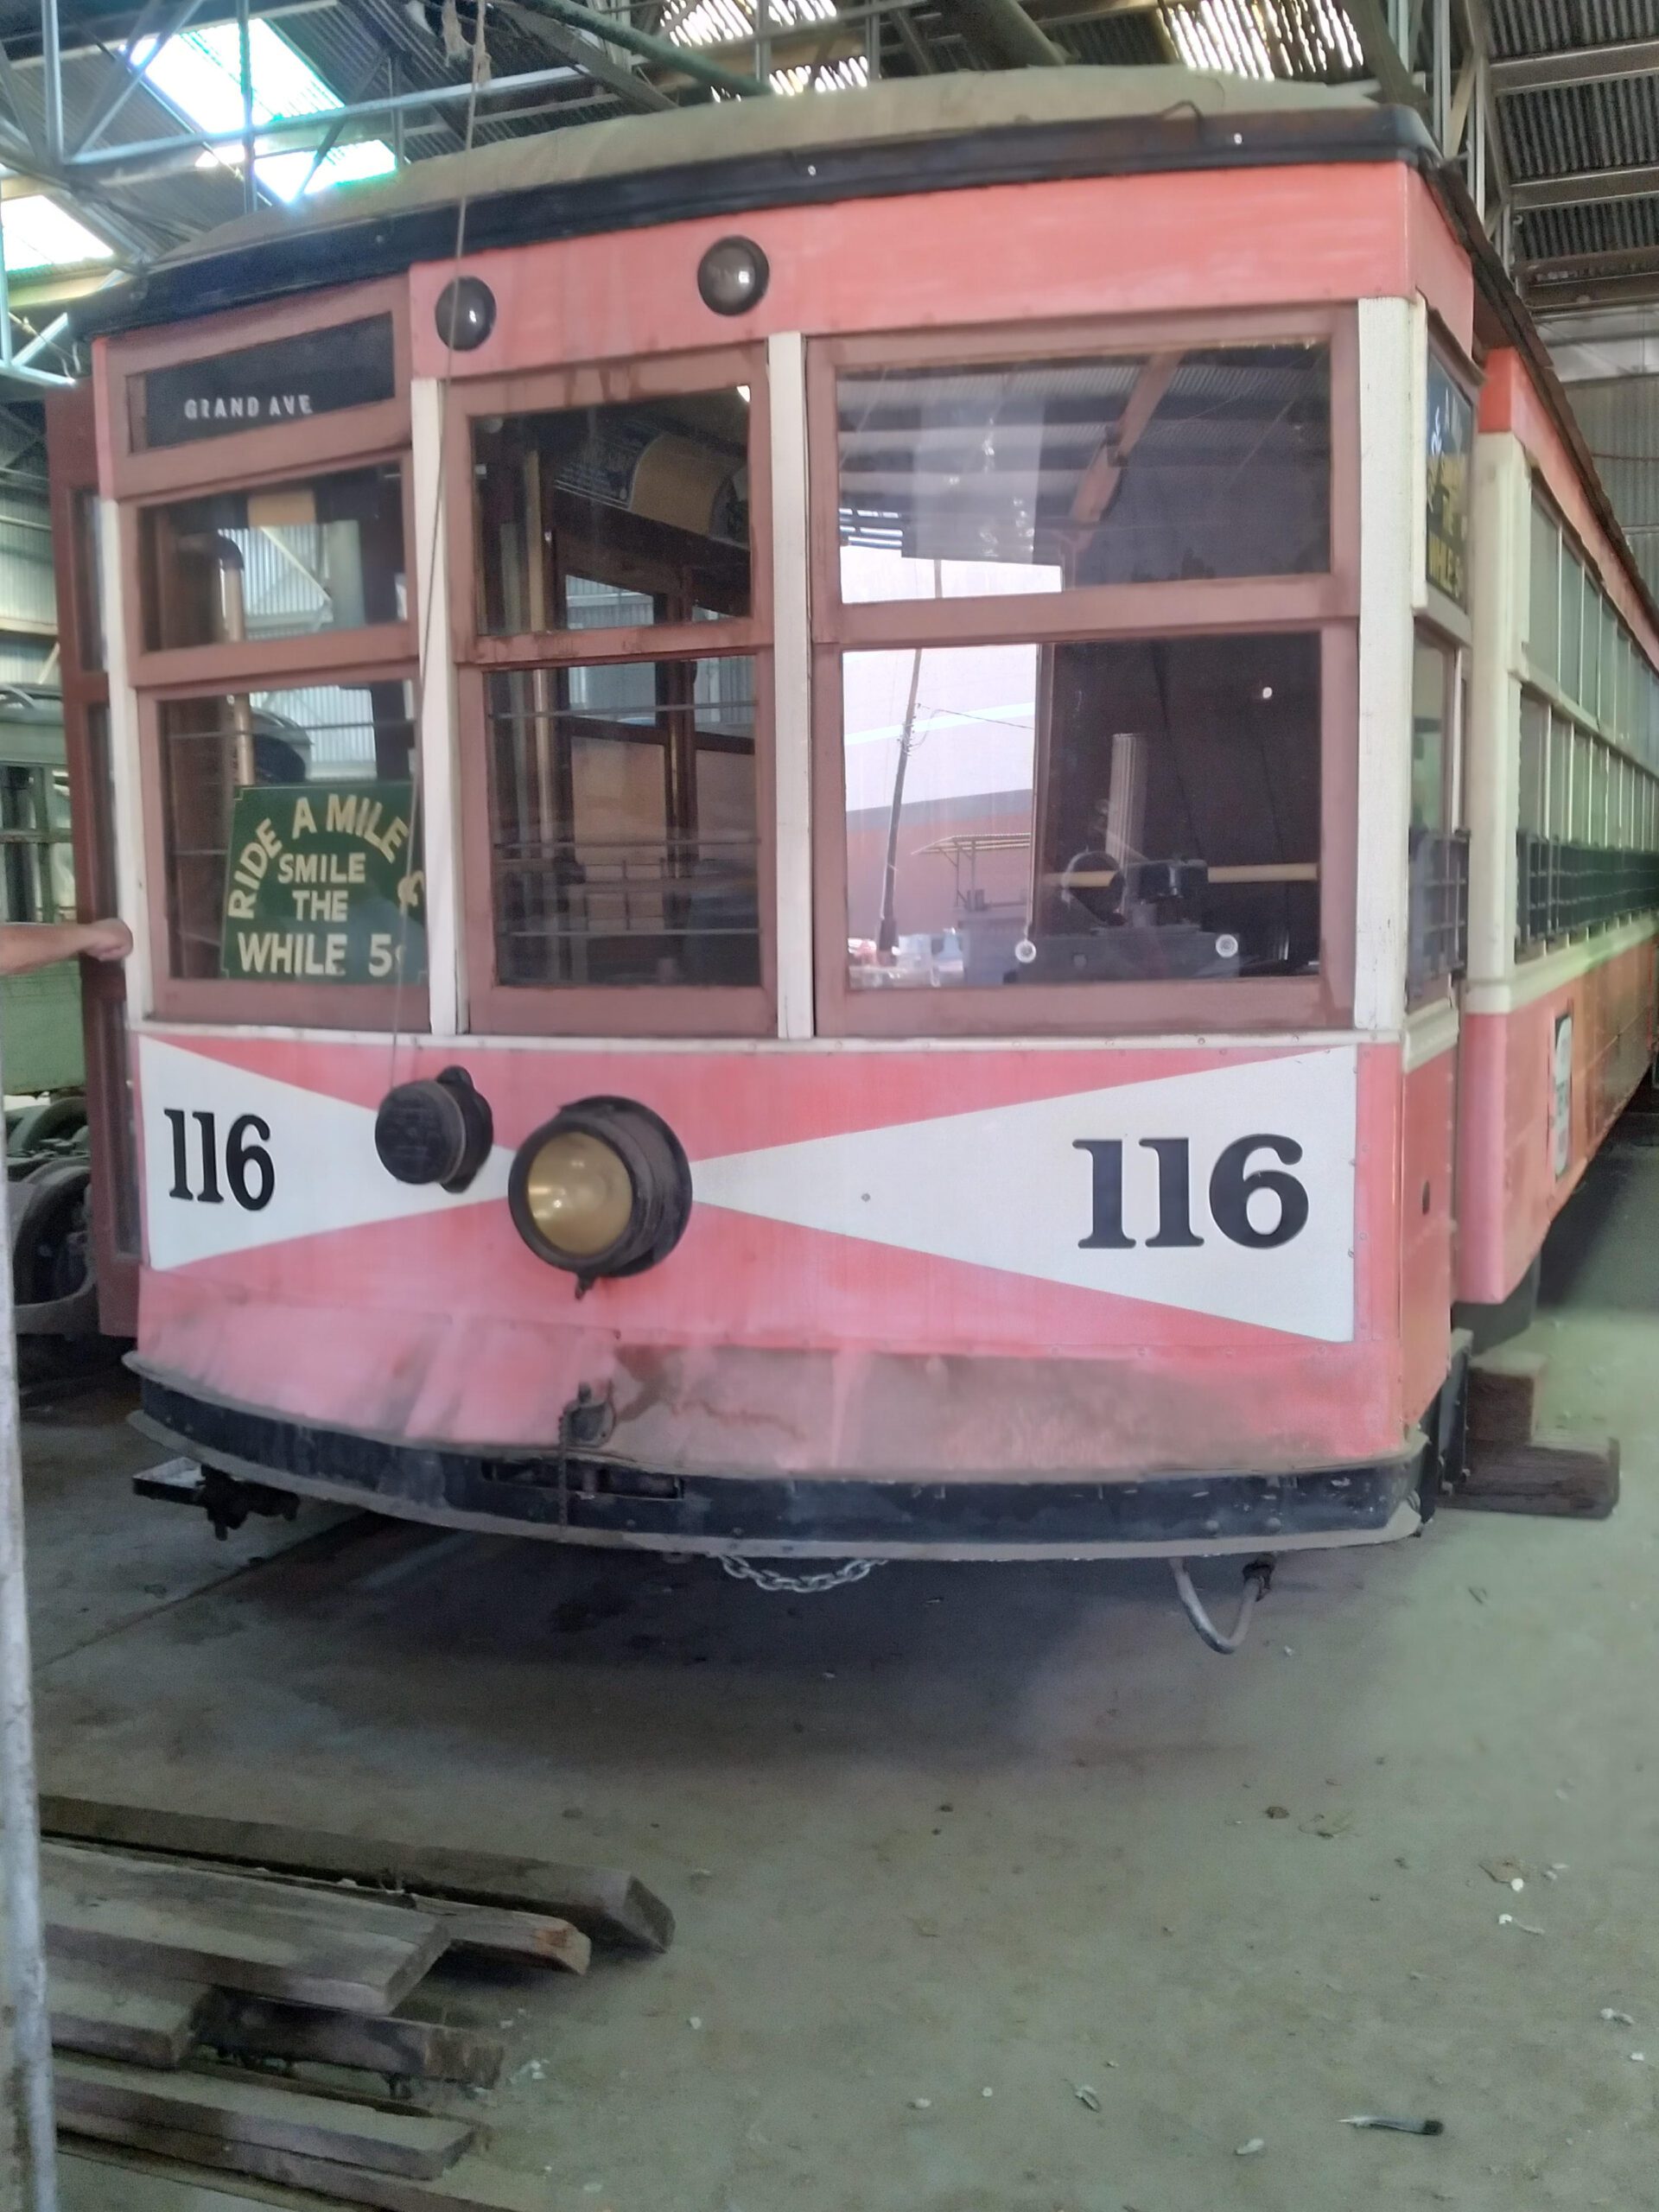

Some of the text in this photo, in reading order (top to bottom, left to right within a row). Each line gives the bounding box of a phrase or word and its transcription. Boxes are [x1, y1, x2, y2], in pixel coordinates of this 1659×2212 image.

[184, 394, 314, 419] GRAND AVE
[227, 817, 283, 919] RIDE
[292, 797, 318, 840] A
[326, 793, 410, 864] MILE
[277, 852, 366, 884] SMILE
[292, 890, 348, 922] THE
[237, 931, 348, 976] WHILE
[164, 1107, 275, 1211] 116
[1072, 1133, 1309, 1249] 116
